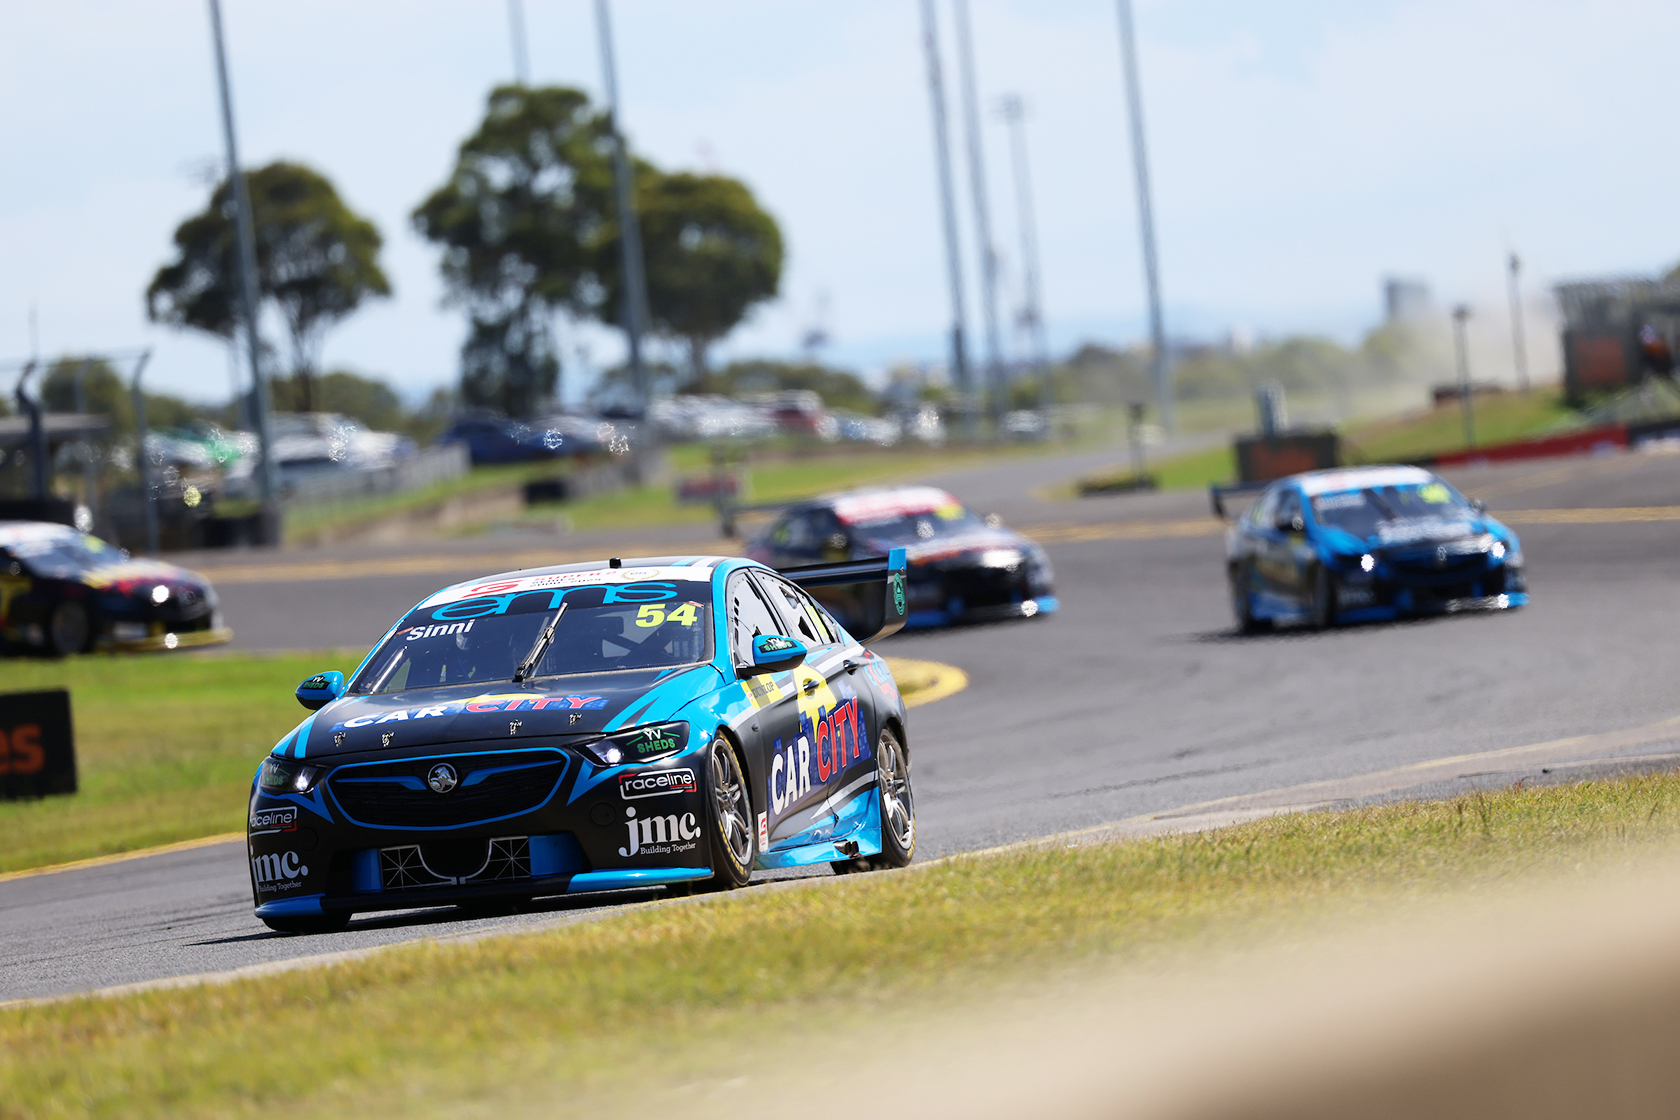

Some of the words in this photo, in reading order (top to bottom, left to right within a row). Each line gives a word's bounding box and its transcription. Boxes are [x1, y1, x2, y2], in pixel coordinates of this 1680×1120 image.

[431, 582, 678, 621] ems
[635, 603, 698, 628] 54
[405, 619, 475, 641] Sinni
[751, 681, 775, 699] DUNLOP
[343, 705, 450, 728] CAR
[465, 695, 603, 713] CITY
[643, 728, 661, 741] YV
[636, 738, 676, 754] SHEDS
[770, 735, 811, 816] CAR
[816, 696, 860, 784] CITY
[624, 772, 693, 791] raceline
[250, 811, 293, 828] aceline
[640, 844, 671, 855] Building
[671, 841, 697, 853] Together
